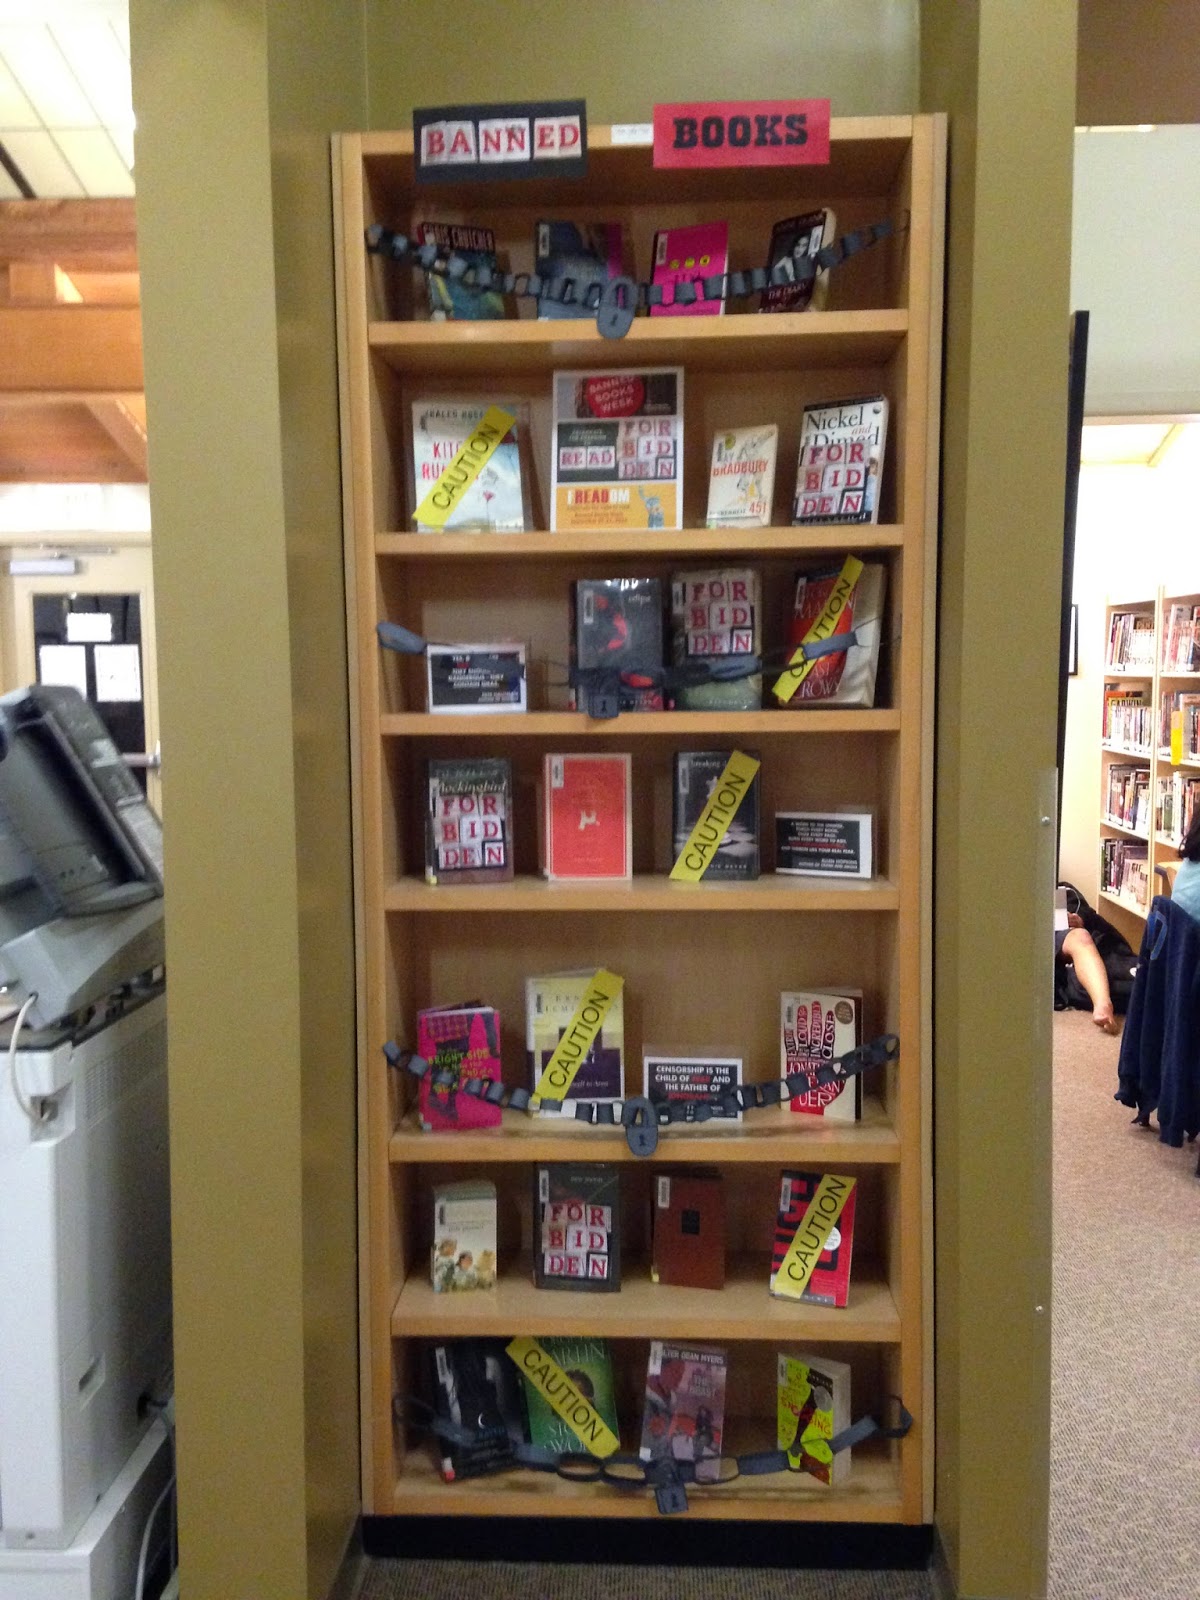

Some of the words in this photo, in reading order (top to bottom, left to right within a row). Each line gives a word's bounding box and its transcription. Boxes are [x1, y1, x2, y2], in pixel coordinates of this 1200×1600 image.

[427, 124, 579, 157] BANNED
[672, 113, 809, 150] BOOKS
[589, 376, 636, 394] BANNED
[594, 384, 635, 404] BOOKS
[625, 420, 671, 437] FOR
[806, 406, 864, 430] Nickel
[851, 422, 873, 435] and
[433, 441, 461, 459] KIT
[562, 452, 613, 466] READ
[624, 440, 671, 457] BID
[809, 442, 864, 464] FOR
[432, 423, 499, 510] CAUTION
[624, 463, 673, 478] DEN
[713, 459, 768, 477] BRADBURY
[805, 468, 862, 490] BID
[749, 501, 767, 514] 451
[802, 495, 861, 515] DEN
[692, 581, 748, 601] FOR
[691, 607, 748, 629] BID
[789, 578, 851, 679] CTION
[693, 634, 750, 654] DEN
[442, 795, 498, 817] FOR
[443, 821, 499, 842] BID
[685, 773, 746, 871] CAUTION
[444, 846, 502, 866] DEN
[549, 990, 610, 1088] CAUTION
[798, 1017, 808, 1048] LOUD
[810, 1003, 821, 1058] INCREDIBLY
[822, 1015, 835, 1060] CLOSE
[655, 1074, 678, 1083] CHILD
[679, 1074, 690, 1083] OF
[712, 1075, 731, 1084] AND
[656, 1065, 705, 1075] CENSORSHIP
[706, 1066, 714, 1075] IS
[716, 1066, 730, 1075] THE
[664, 1083, 679, 1091] THE
[680, 1083, 709, 1092] FATHER
[710, 1084, 721, 1092] OF
[551, 1201, 605, 1227] FOR
[550, 1229, 605, 1250] BID
[788, 1177, 847, 1281] CAUTION
[550, 1256, 606, 1278] DEN
[523, 1350, 604, 1442] CAUTION
